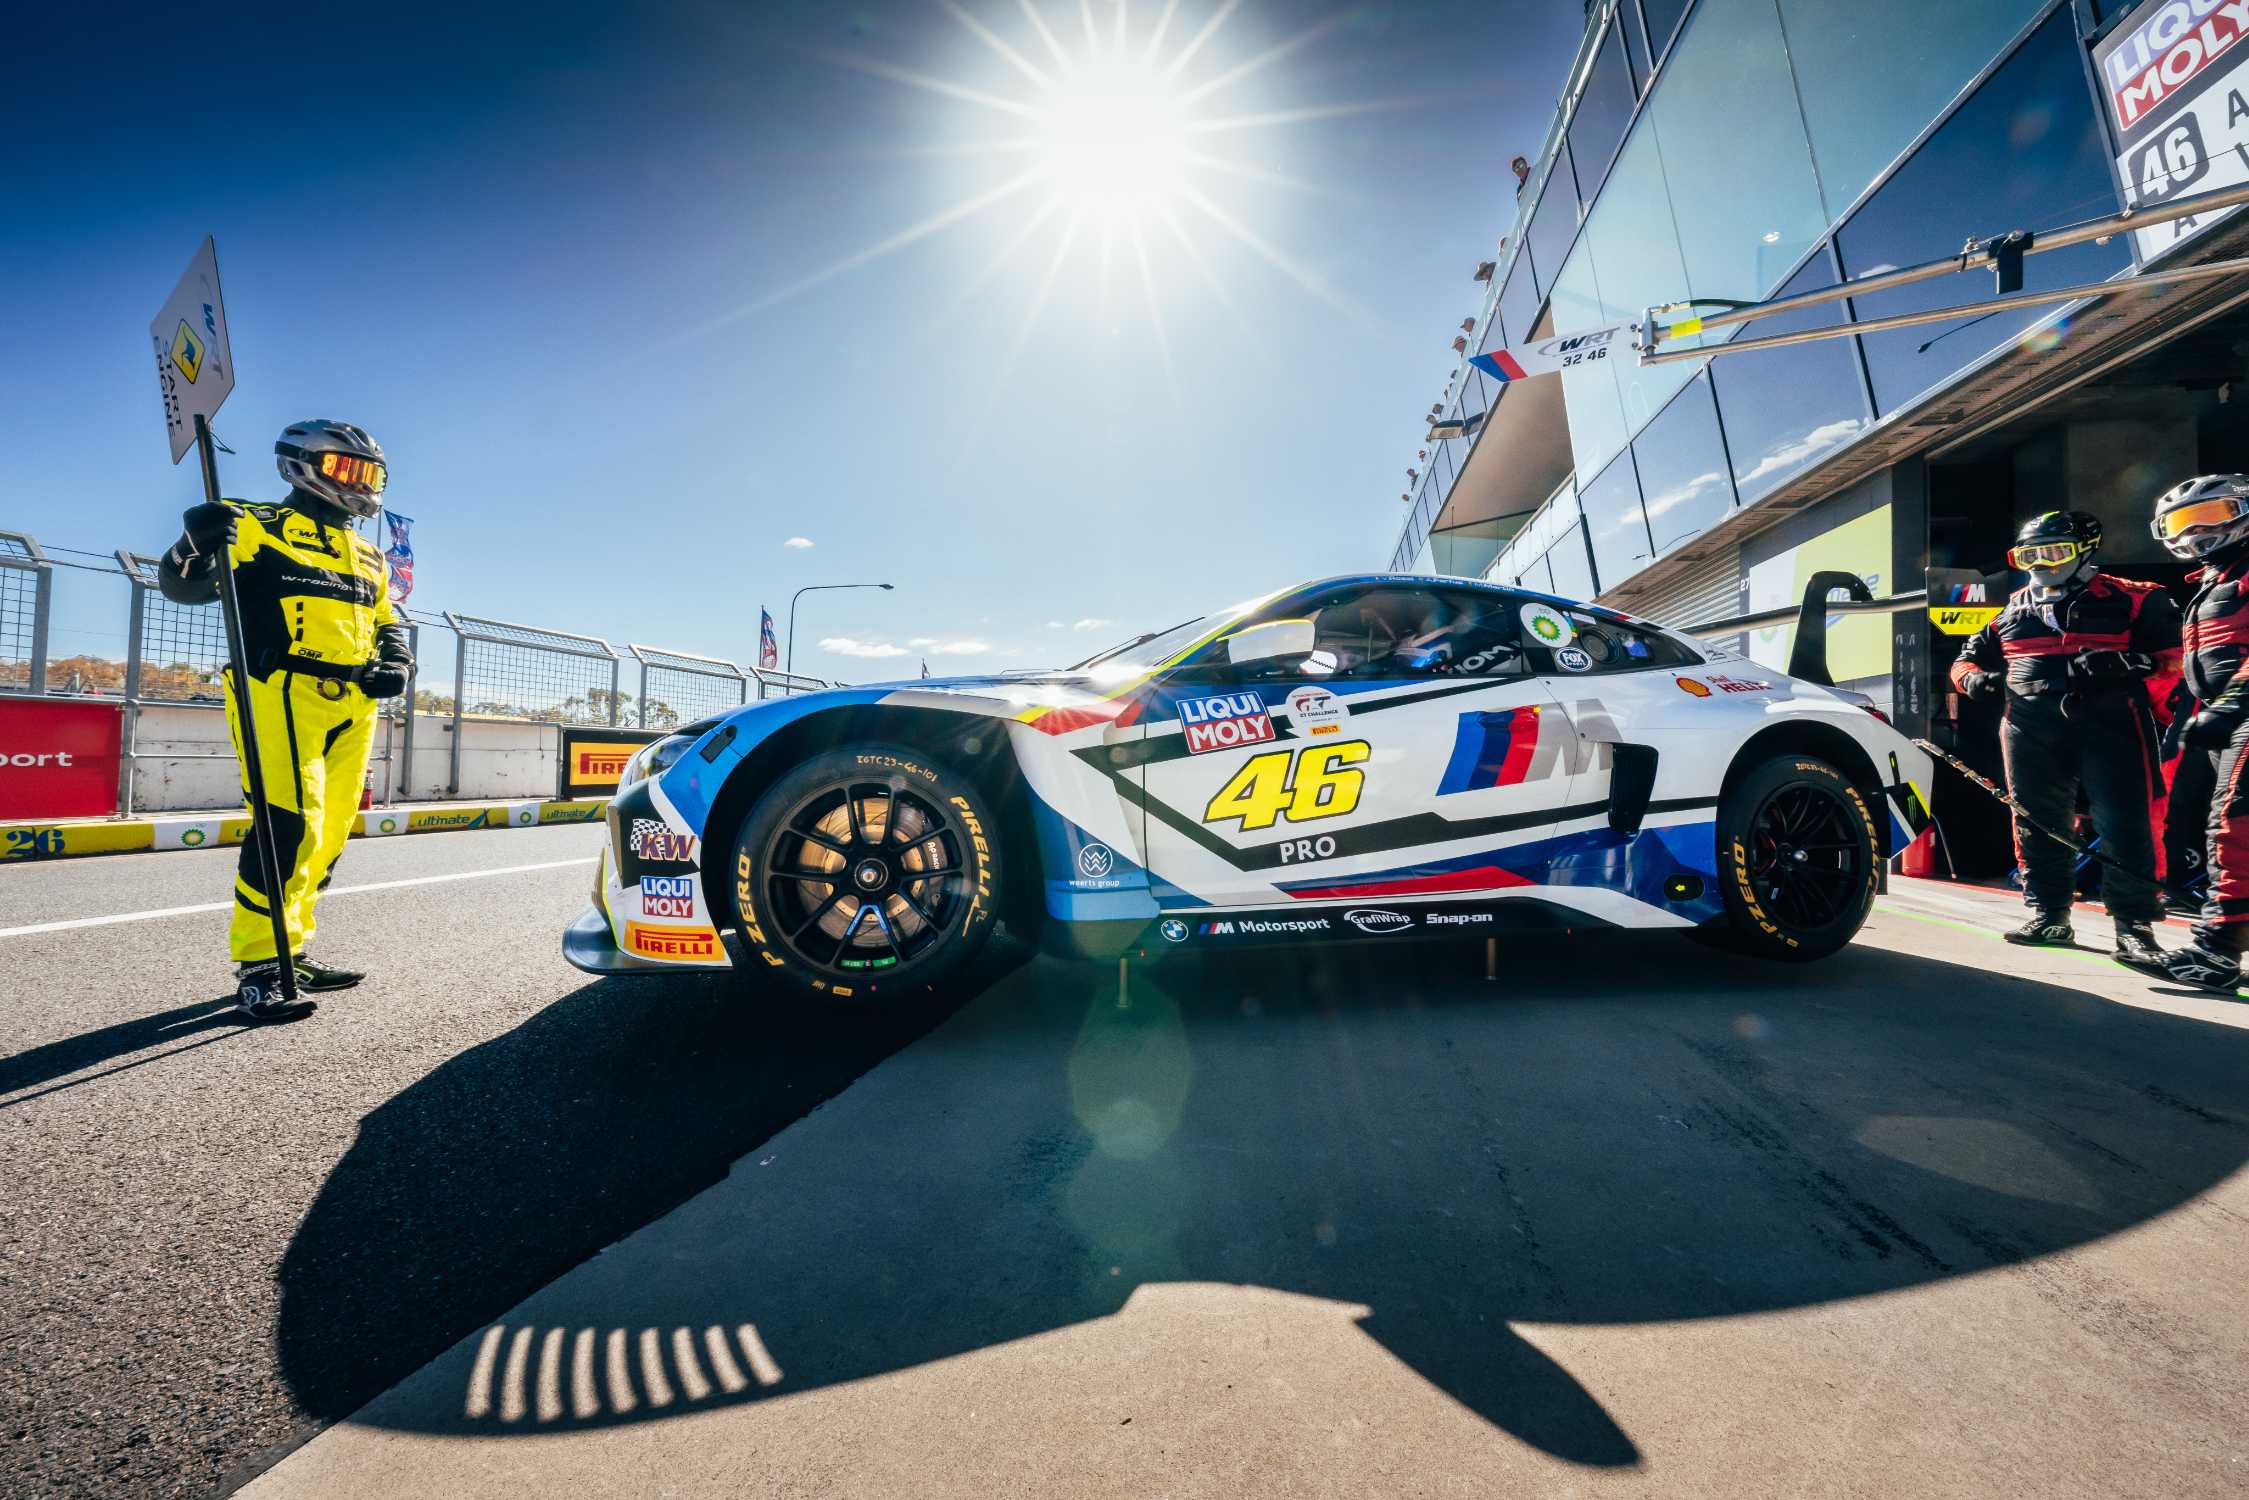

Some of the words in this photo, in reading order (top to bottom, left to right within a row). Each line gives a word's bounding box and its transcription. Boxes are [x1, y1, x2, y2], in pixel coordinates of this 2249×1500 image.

[2142, 126, 2198, 196] 46
[1559, 327, 1620, 353] WRT
[1562, 353, 1582, 367] 32
[1587, 347, 1608, 361] 46
[152, 335, 176, 439] ENGINE
[163, 338, 183, 433] START
[1940, 611, 1986, 625] WRT
[298, 647, 323, 660] OMP
[1561, 652, 1584, 664] FOX
[1182, 693, 1260, 723] LIQUI
[1189, 716, 1266, 750] MOLY
[1202, 738, 1372, 833] 46
[417, 813, 470, 828] ultimate
[546, 807, 585, 820] ultimate
[6, 827, 66, 857] 26
[638, 832, 698, 862] KW
[950, 795, 992, 897] PIRELLI
[1279, 836, 1336, 864] PRO
[642, 878, 691, 897] LIQUI
[1097, 880, 1120, 888] group
[1733, 841, 1767, 921] ZERO
[644, 897, 692, 917] MOLY
[737, 853, 767, 945] ZERO
[1240, 918, 1331, 934] Motorsport
[1350, 912, 1411, 927] GrafiWrap
[1426, 912, 1493, 926] Snap-on
[635, 928, 714, 955] PIRELLI
